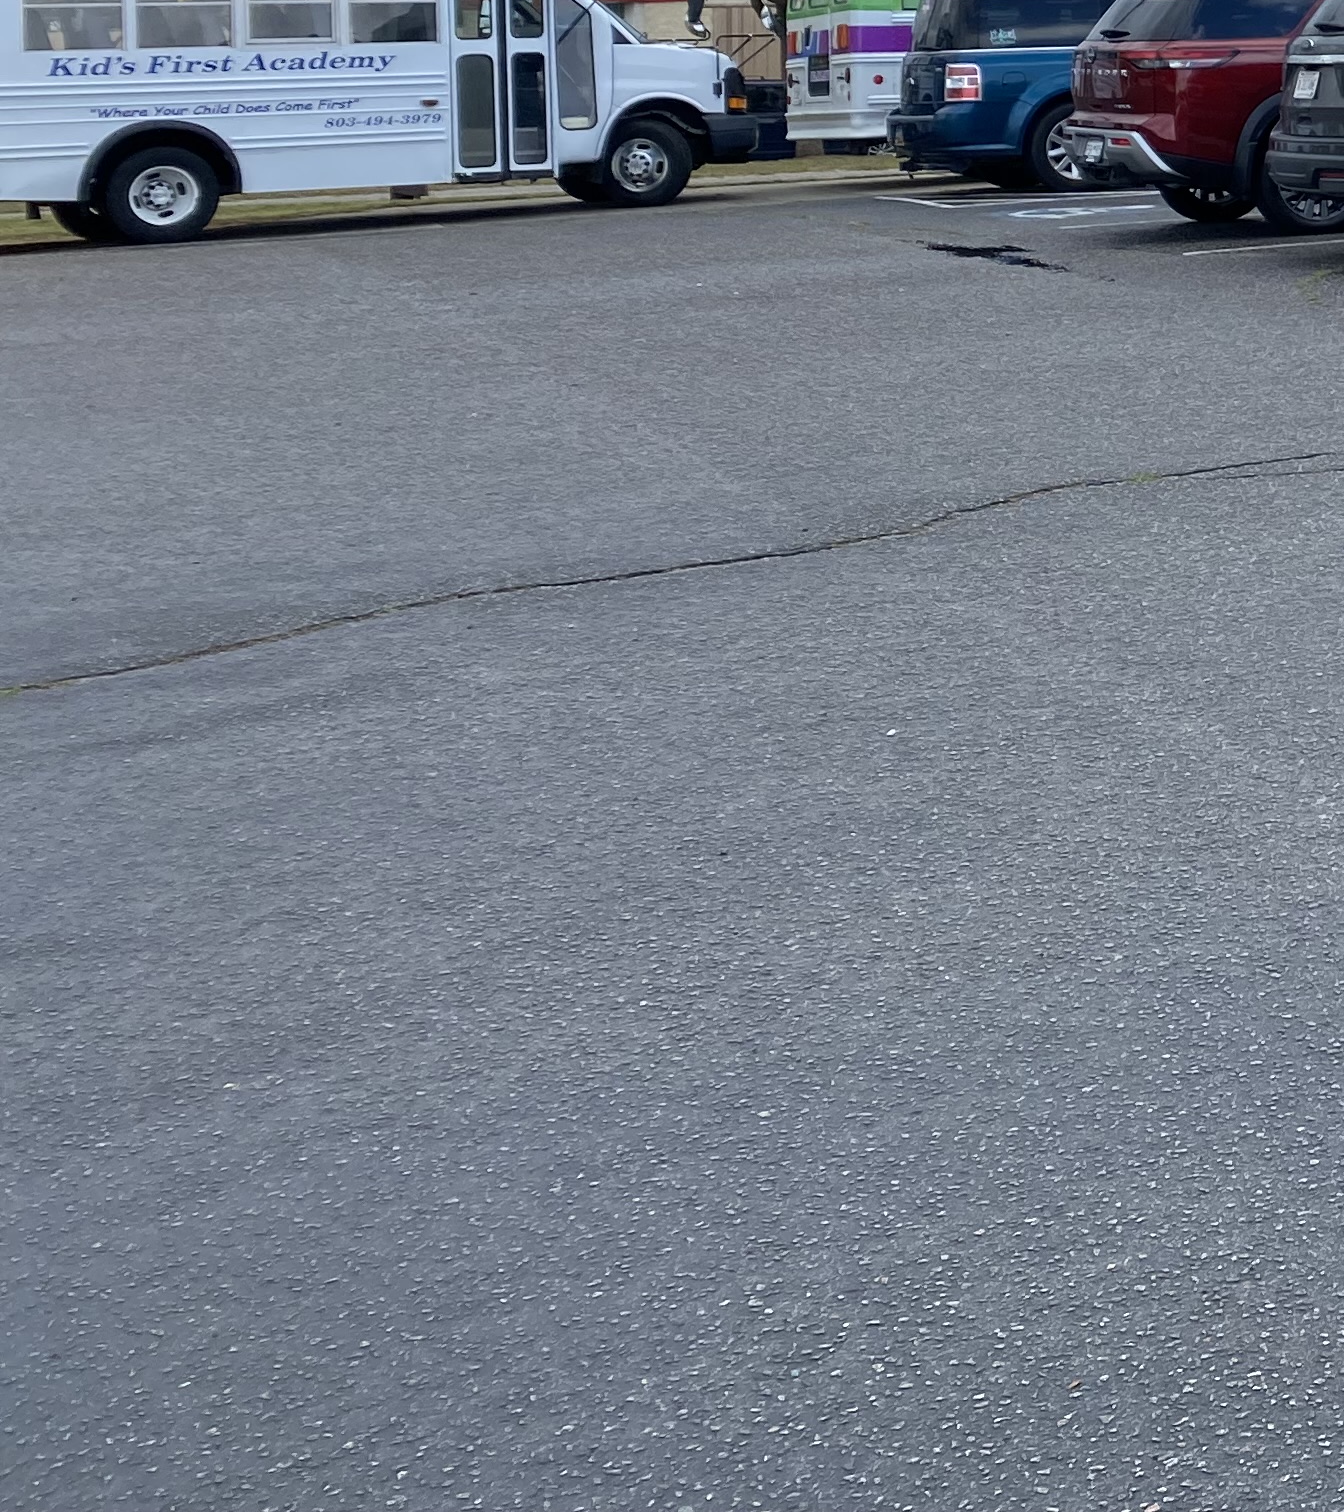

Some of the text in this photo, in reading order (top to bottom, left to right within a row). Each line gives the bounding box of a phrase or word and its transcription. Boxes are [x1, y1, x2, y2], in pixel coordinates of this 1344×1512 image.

[47, 51, 396, 76] Kid's First Academy
[154, 106, 188, 116] Your
[193, 104, 230, 115] Child
[235, 103, 271, 114] Does
[275, 101, 313, 112] Come
[324, 113, 442, 128] 803-494-3979
